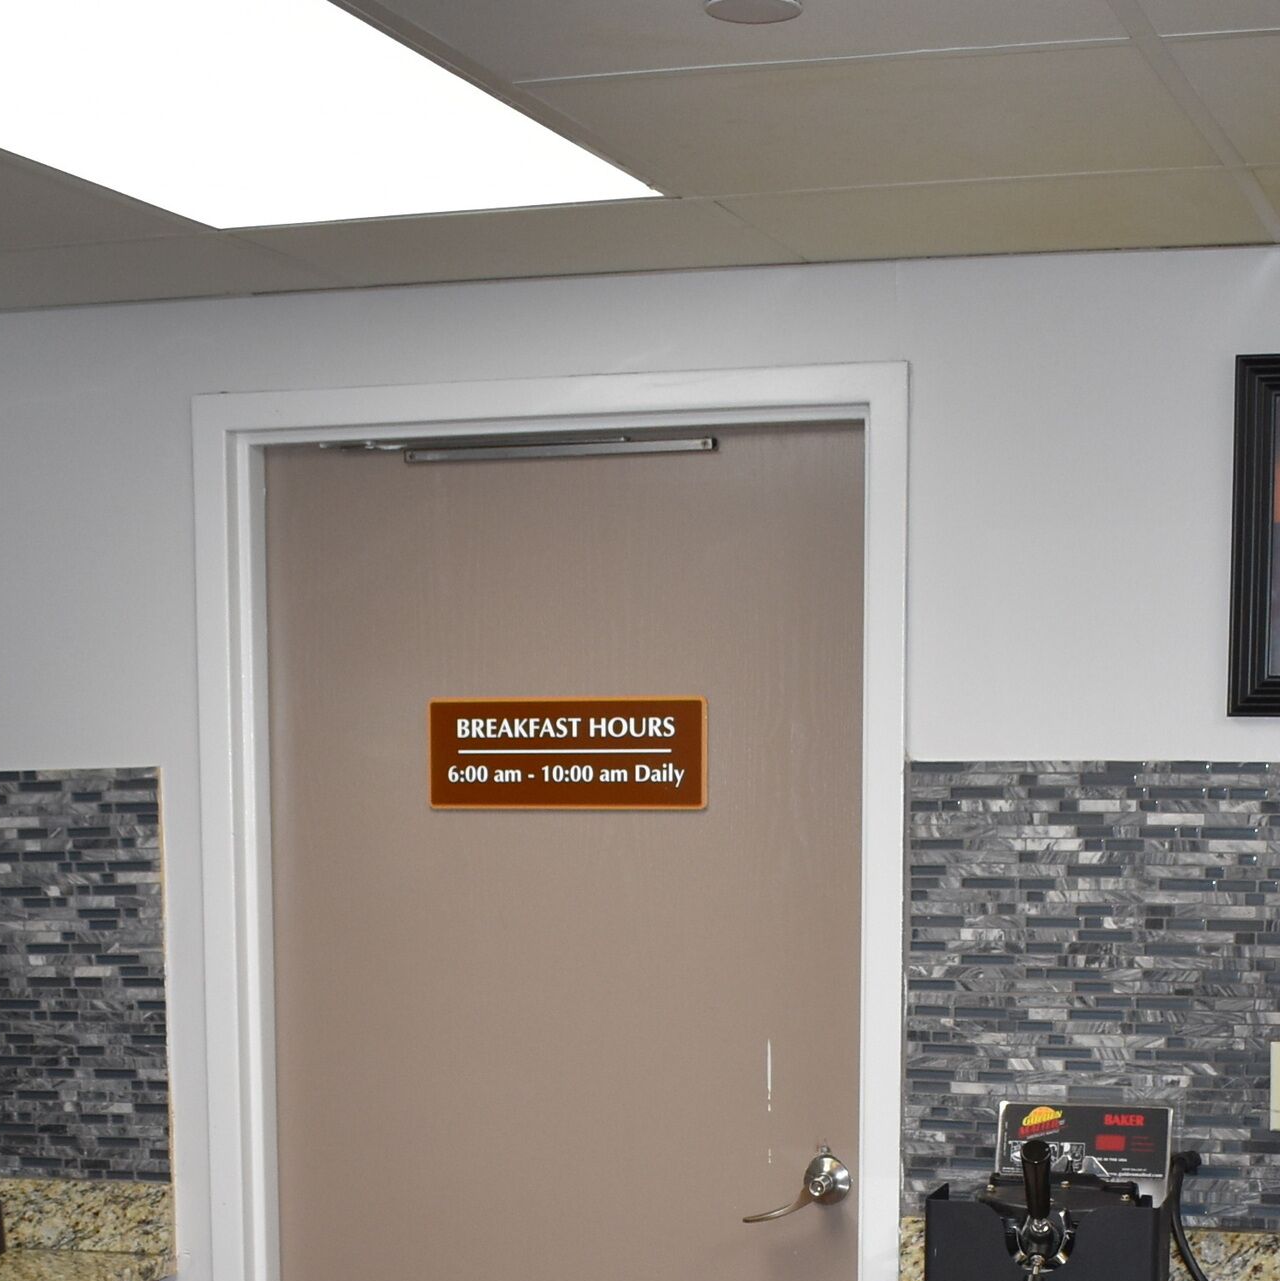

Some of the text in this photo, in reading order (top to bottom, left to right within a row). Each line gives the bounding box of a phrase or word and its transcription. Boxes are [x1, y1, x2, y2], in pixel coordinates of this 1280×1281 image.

[456, 716, 675, 738] BREAKFAST HOURS
[448, 766, 488, 783] 6:00
[494, 768, 522, 782] am
[541, 765, 593, 782] 10:00
[599, 767, 628, 782] am
[635, 763, 684, 788] Daily
[1104, 1114, 1144, 1126] BAKER
